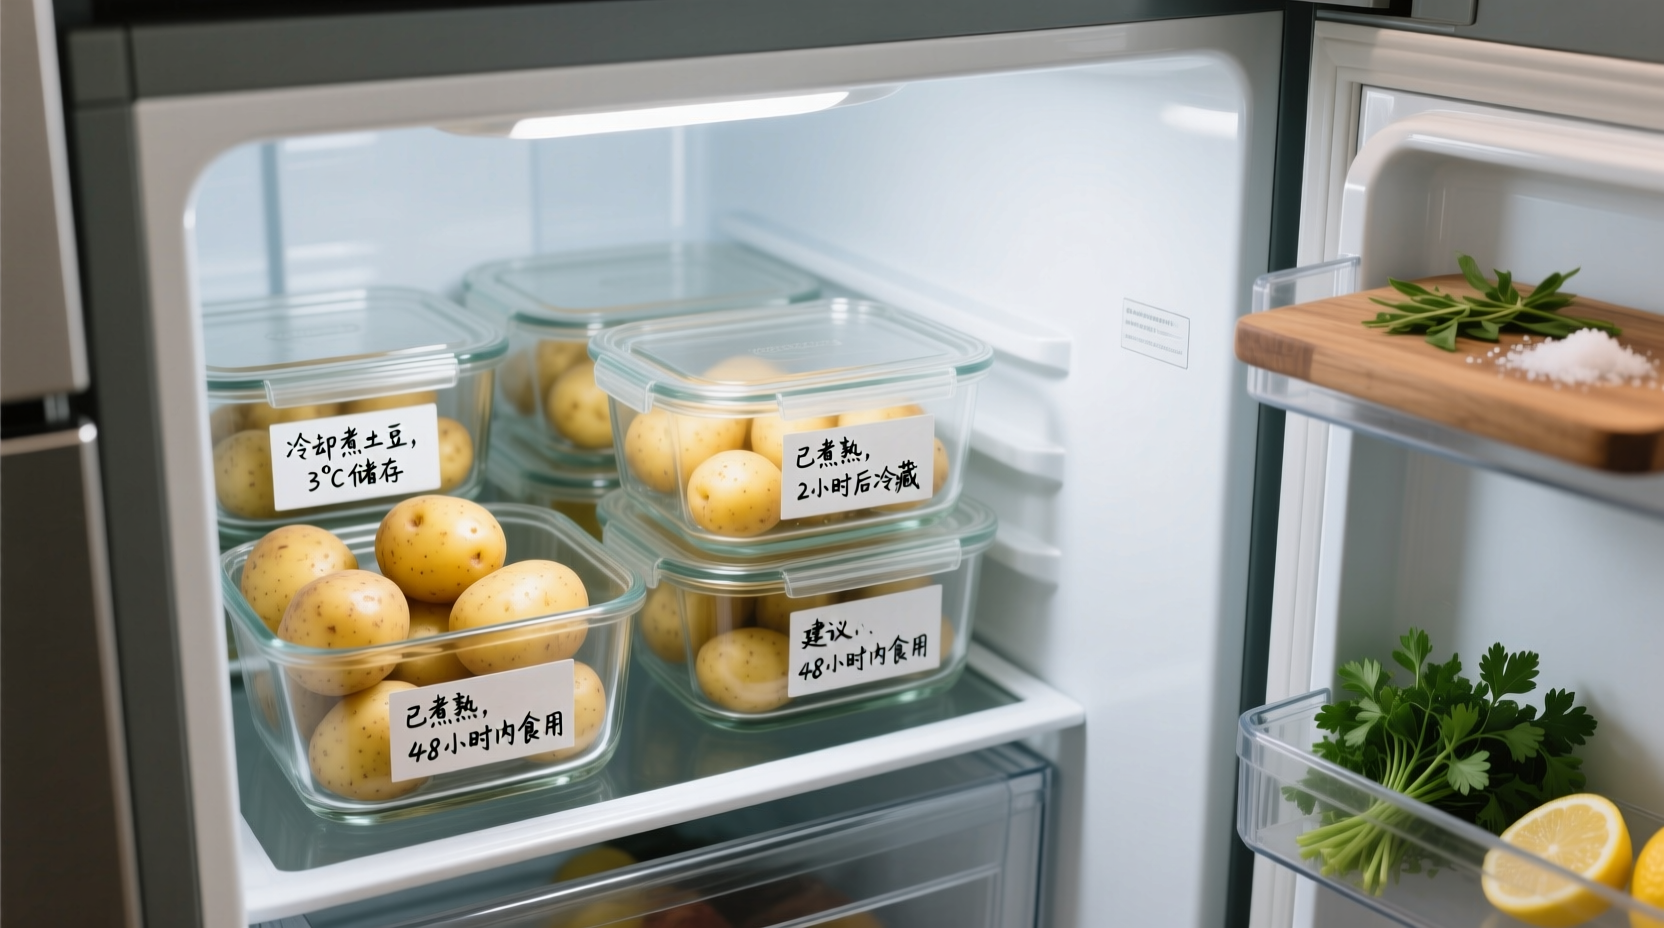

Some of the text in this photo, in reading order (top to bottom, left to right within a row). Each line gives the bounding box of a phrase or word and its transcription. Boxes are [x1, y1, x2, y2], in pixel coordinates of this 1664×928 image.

[286, 422, 416, 461] 冷却煮土豆，
[308, 457, 404, 492] 3°C储存
[797, 459, 920, 501] 2小时后冷藏
[798, 633, 928, 681] 48小时内食用
[408, 711, 563, 763] 48小时内食用
